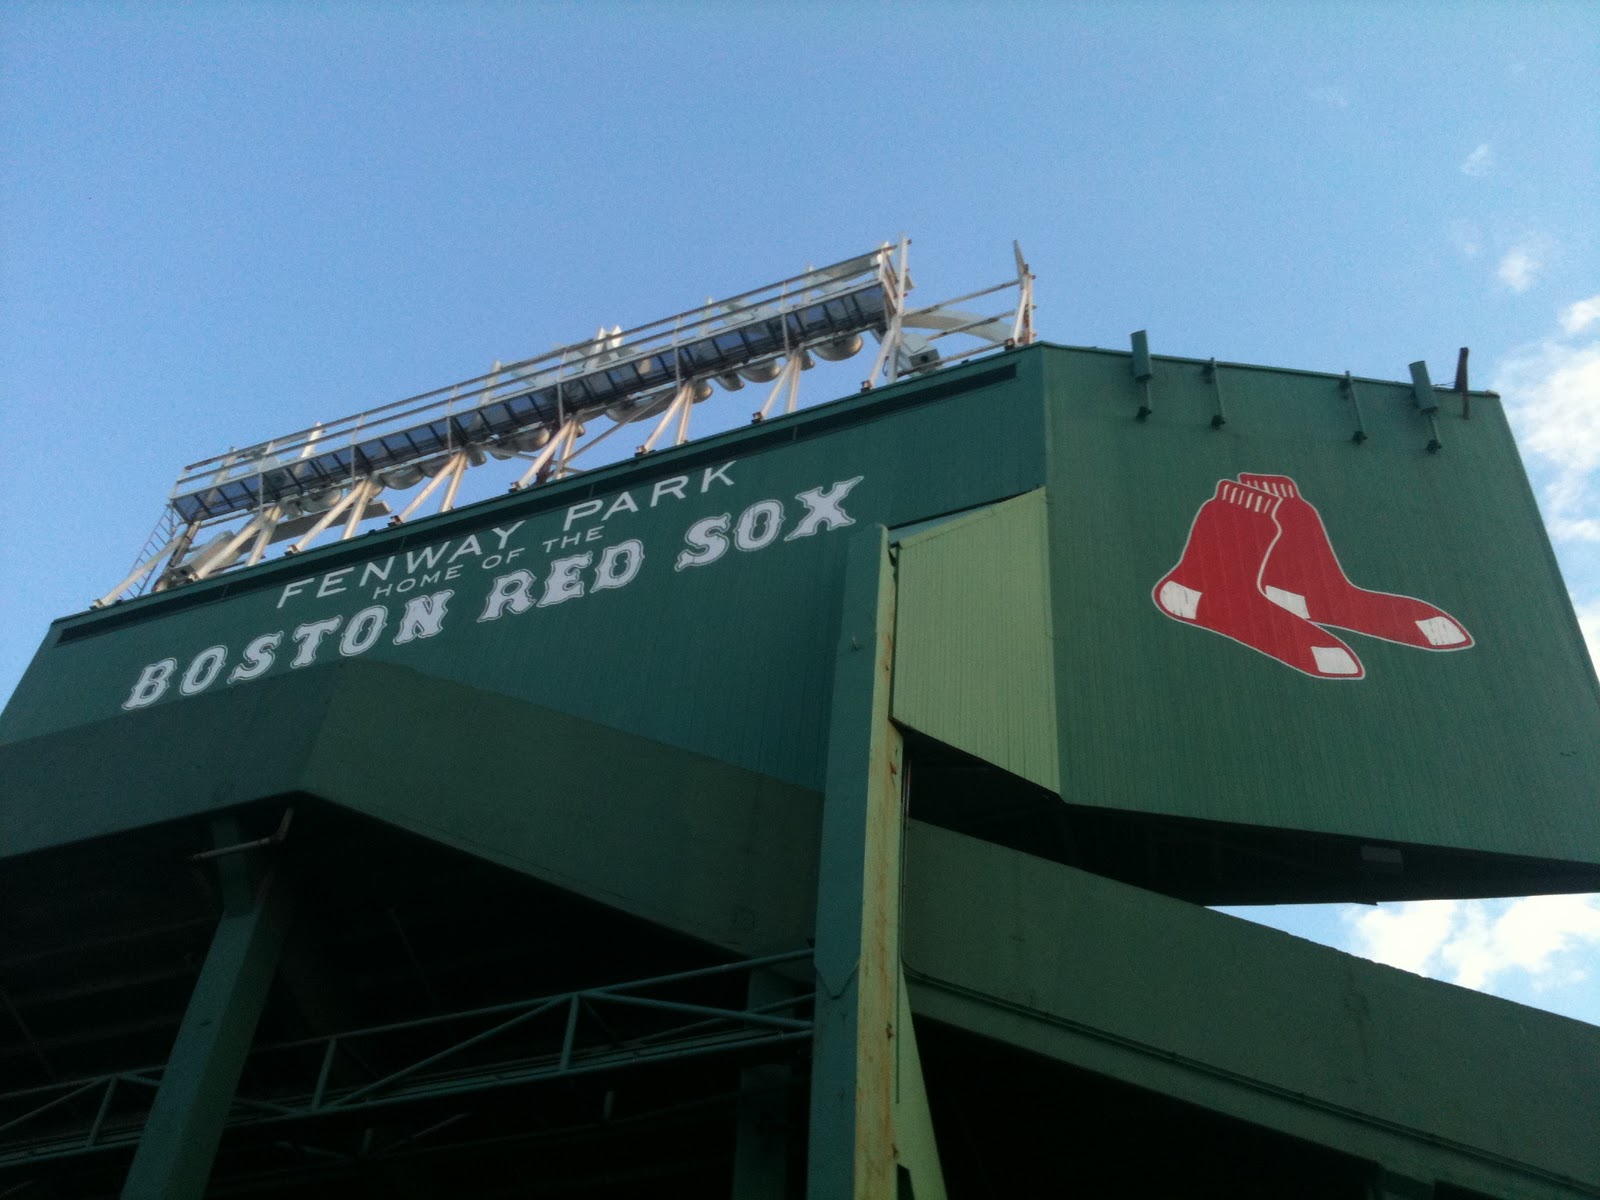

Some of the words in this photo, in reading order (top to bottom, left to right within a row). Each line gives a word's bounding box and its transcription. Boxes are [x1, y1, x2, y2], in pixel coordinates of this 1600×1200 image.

[122, 588, 455, 711] BOSTON
[477, 538, 644, 622] RED
[675, 475, 864, 572] SOX
[276, 519, 528, 611] FENWAY
[562, 459, 736, 532] PARK
[371, 562, 464, 601] HOME
[479, 546, 527, 571] OF
[542, 525, 605, 555] THE
